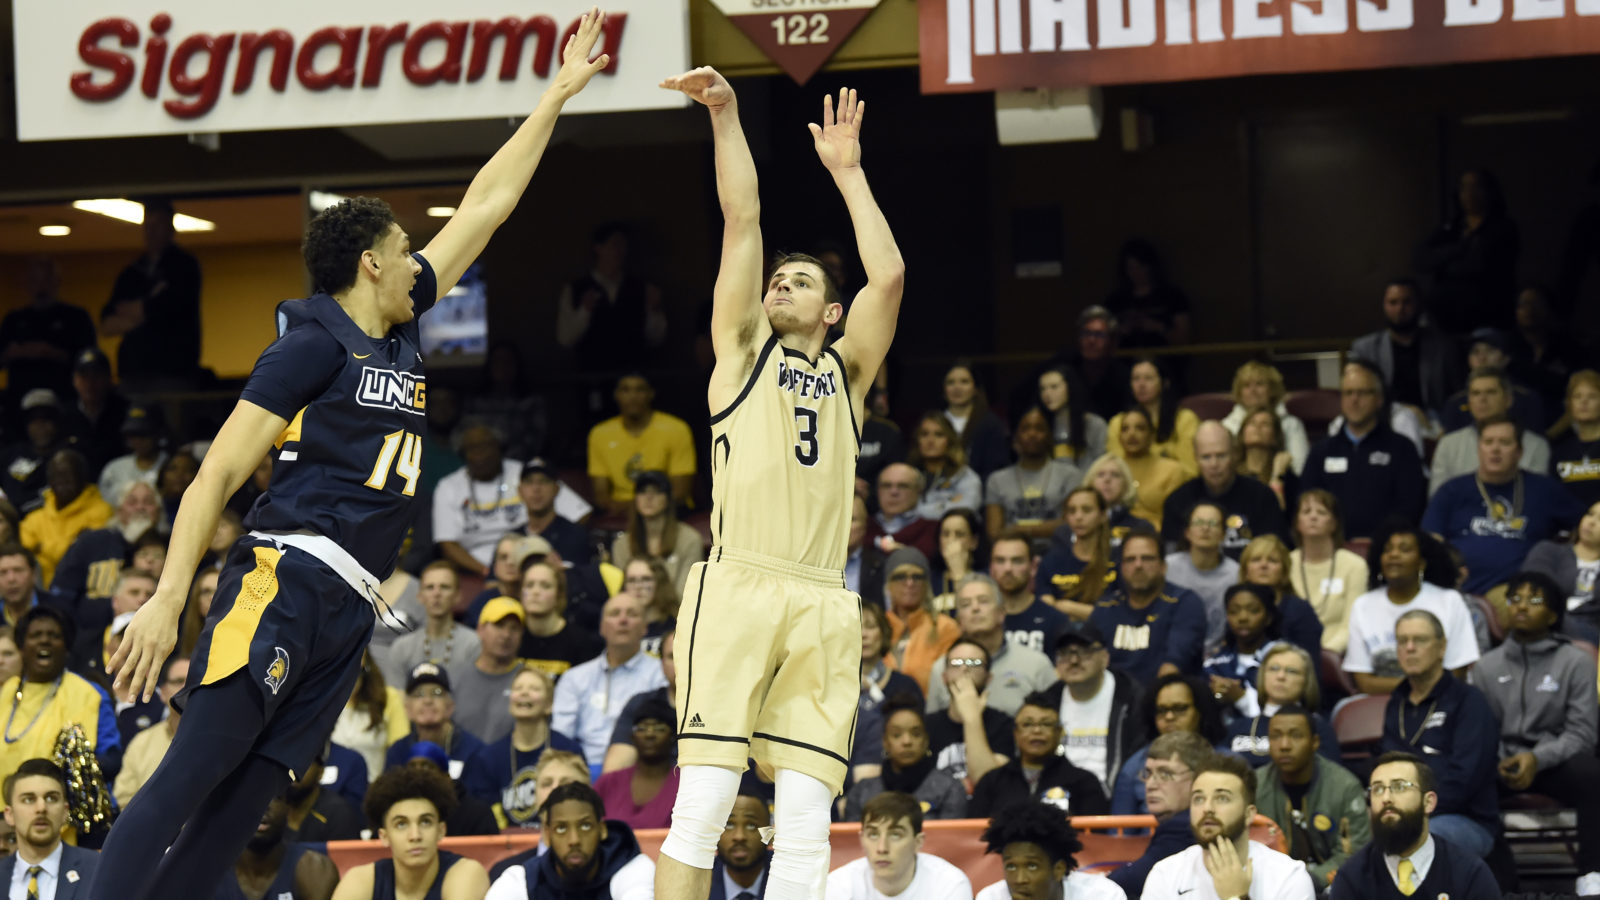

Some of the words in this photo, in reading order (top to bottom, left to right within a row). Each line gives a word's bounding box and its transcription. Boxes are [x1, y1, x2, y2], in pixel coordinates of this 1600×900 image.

[771, 13, 830, 45] 122
[70, 12, 628, 119] Signarama
[359, 369, 425, 411] UNCG
[364, 429, 422, 496] 14
[794, 406, 819, 467] 3
